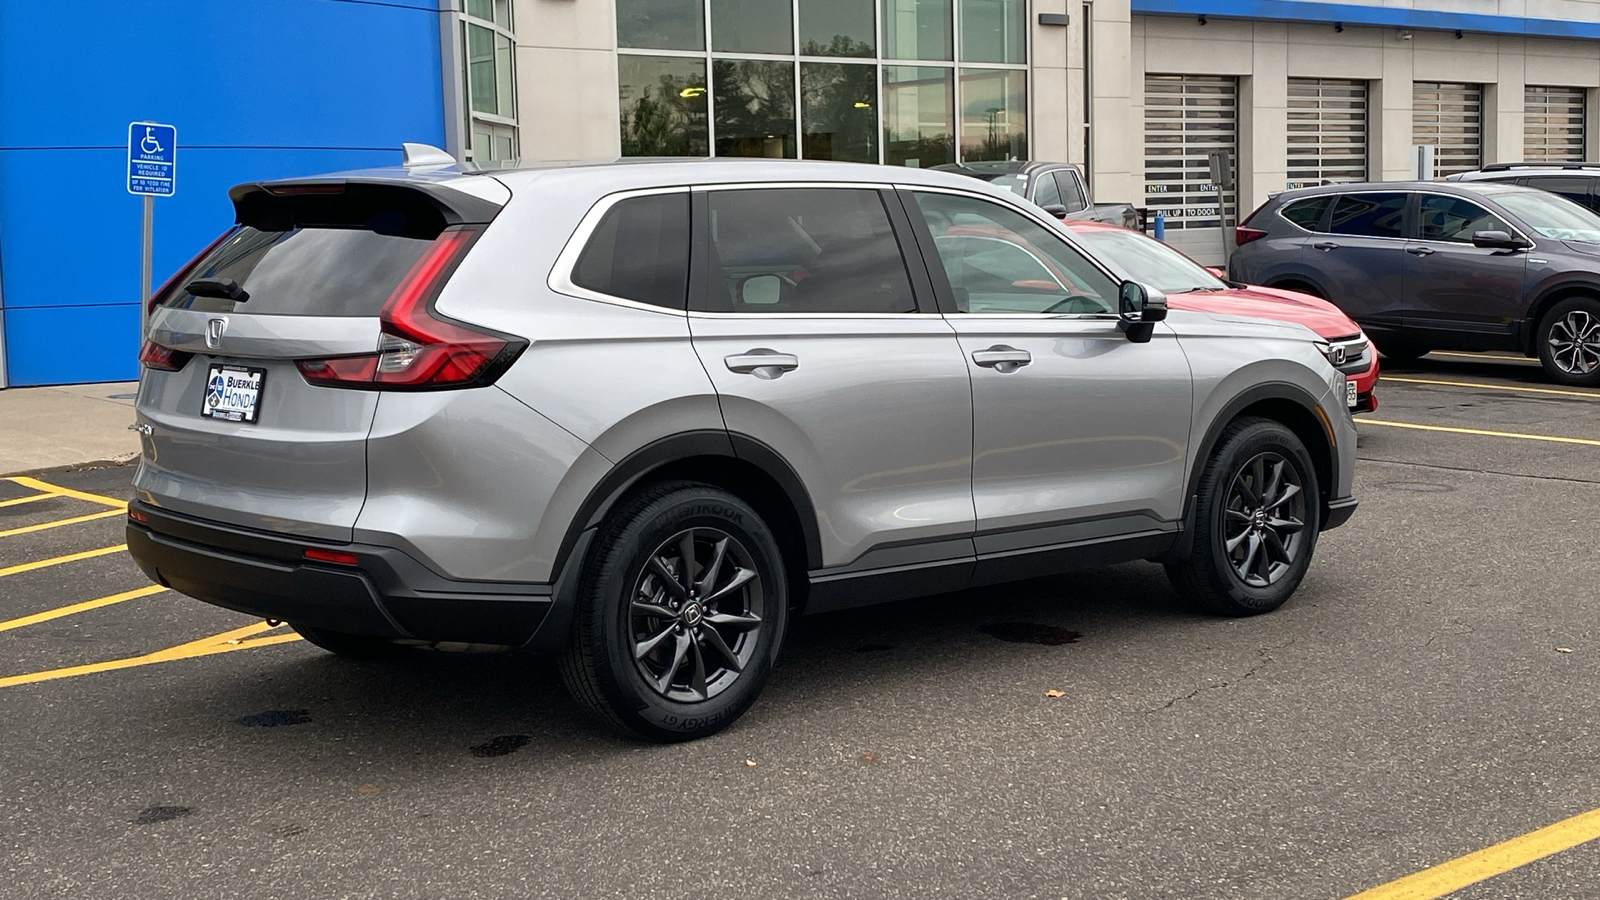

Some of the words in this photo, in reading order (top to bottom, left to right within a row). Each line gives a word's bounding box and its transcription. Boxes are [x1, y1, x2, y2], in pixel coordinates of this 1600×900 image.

[1148, 185, 1168, 193] ENTER
[1156, 209, 1172, 217] PULL
[1172, 209, 1181, 217] UP
[1197, 208, 1216, 216] DOOR
[227, 376, 259, 390] BUERKLE
[223, 388, 256, 408] HONDA
